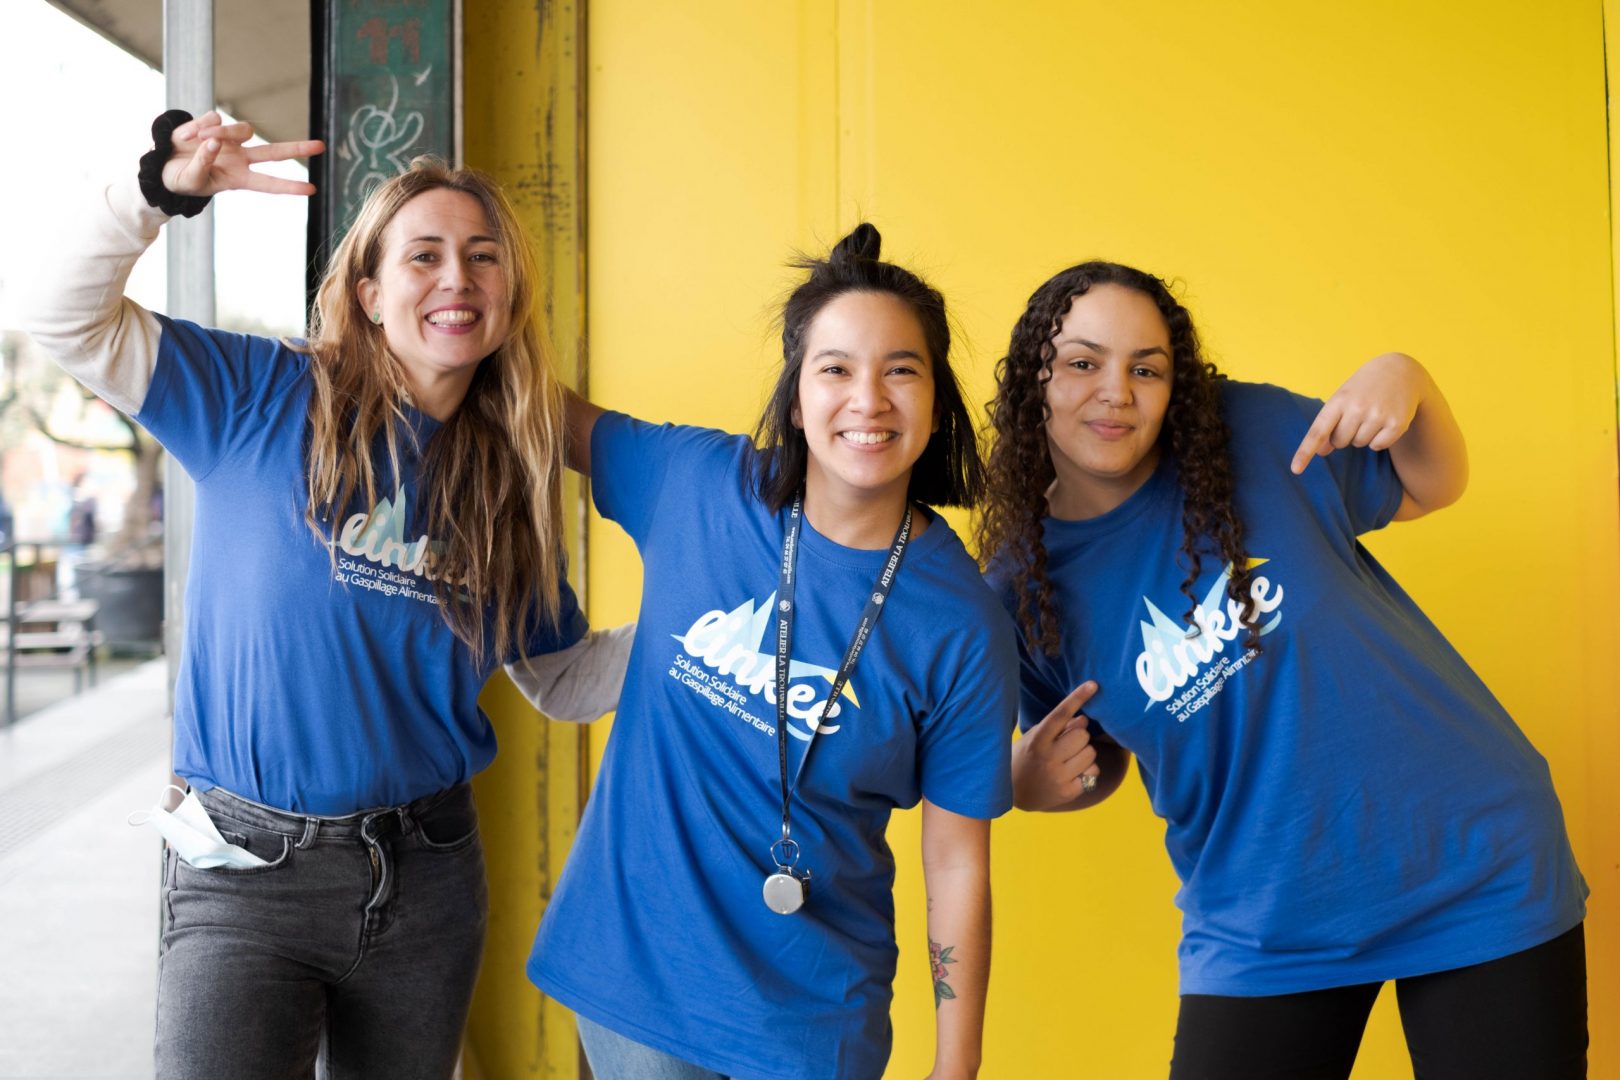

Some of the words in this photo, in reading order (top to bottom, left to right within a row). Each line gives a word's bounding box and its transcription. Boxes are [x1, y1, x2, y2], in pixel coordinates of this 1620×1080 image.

[335, 571, 349, 584] au
[350, 573, 398, 597] Gaspillage
[338, 557, 377, 578] Solution
[377, 568, 416, 588] Solidaire
[881, 554, 898, 587] ATELIER
[894, 544, 902, 555] LA
[780, 619, 788, 653] ATELIER
[673, 654, 710, 686] Solution
[710, 675, 747, 705] Solidaire
[779, 654, 787, 666] LA
[668, 666, 682, 682] au
[681, 671, 725, 707] Gaspillage
[723, 701, 776, 737] Alimentaire
[1166, 685, 1201, 714] Solution
[1196, 656, 1230, 690] Solidaire
[1176, 708, 1190, 723] au
[1186, 675, 1225, 714] Gaspillage
